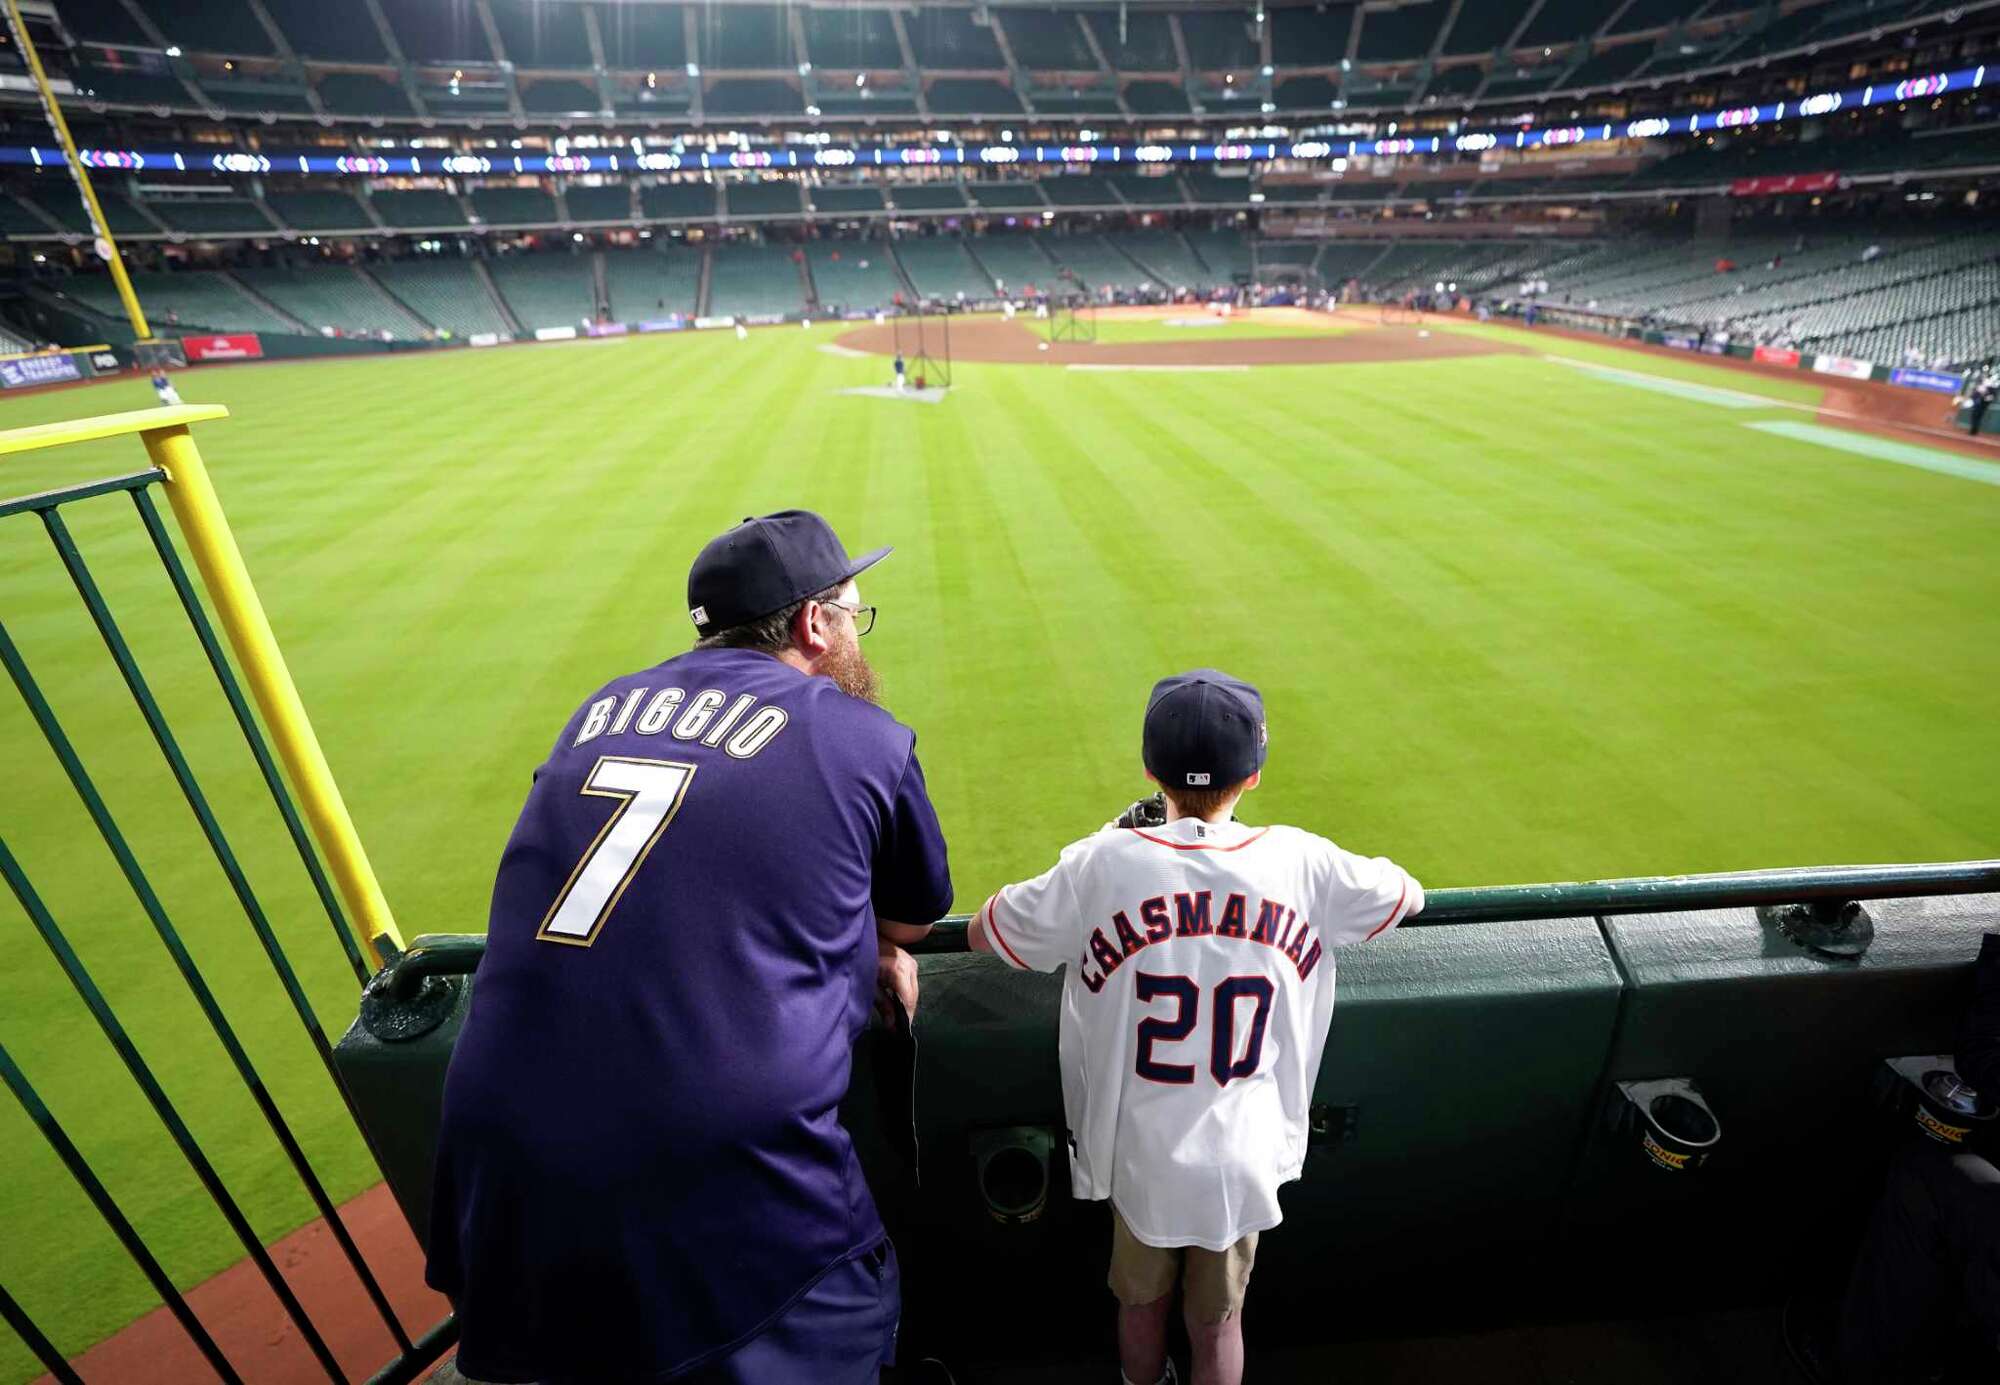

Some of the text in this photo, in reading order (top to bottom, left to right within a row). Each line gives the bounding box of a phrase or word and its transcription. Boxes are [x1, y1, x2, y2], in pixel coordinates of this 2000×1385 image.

[572, 687, 789, 760] BIGGIO
[536, 755, 698, 948] 7
[1135, 971, 1275, 1088] 20
